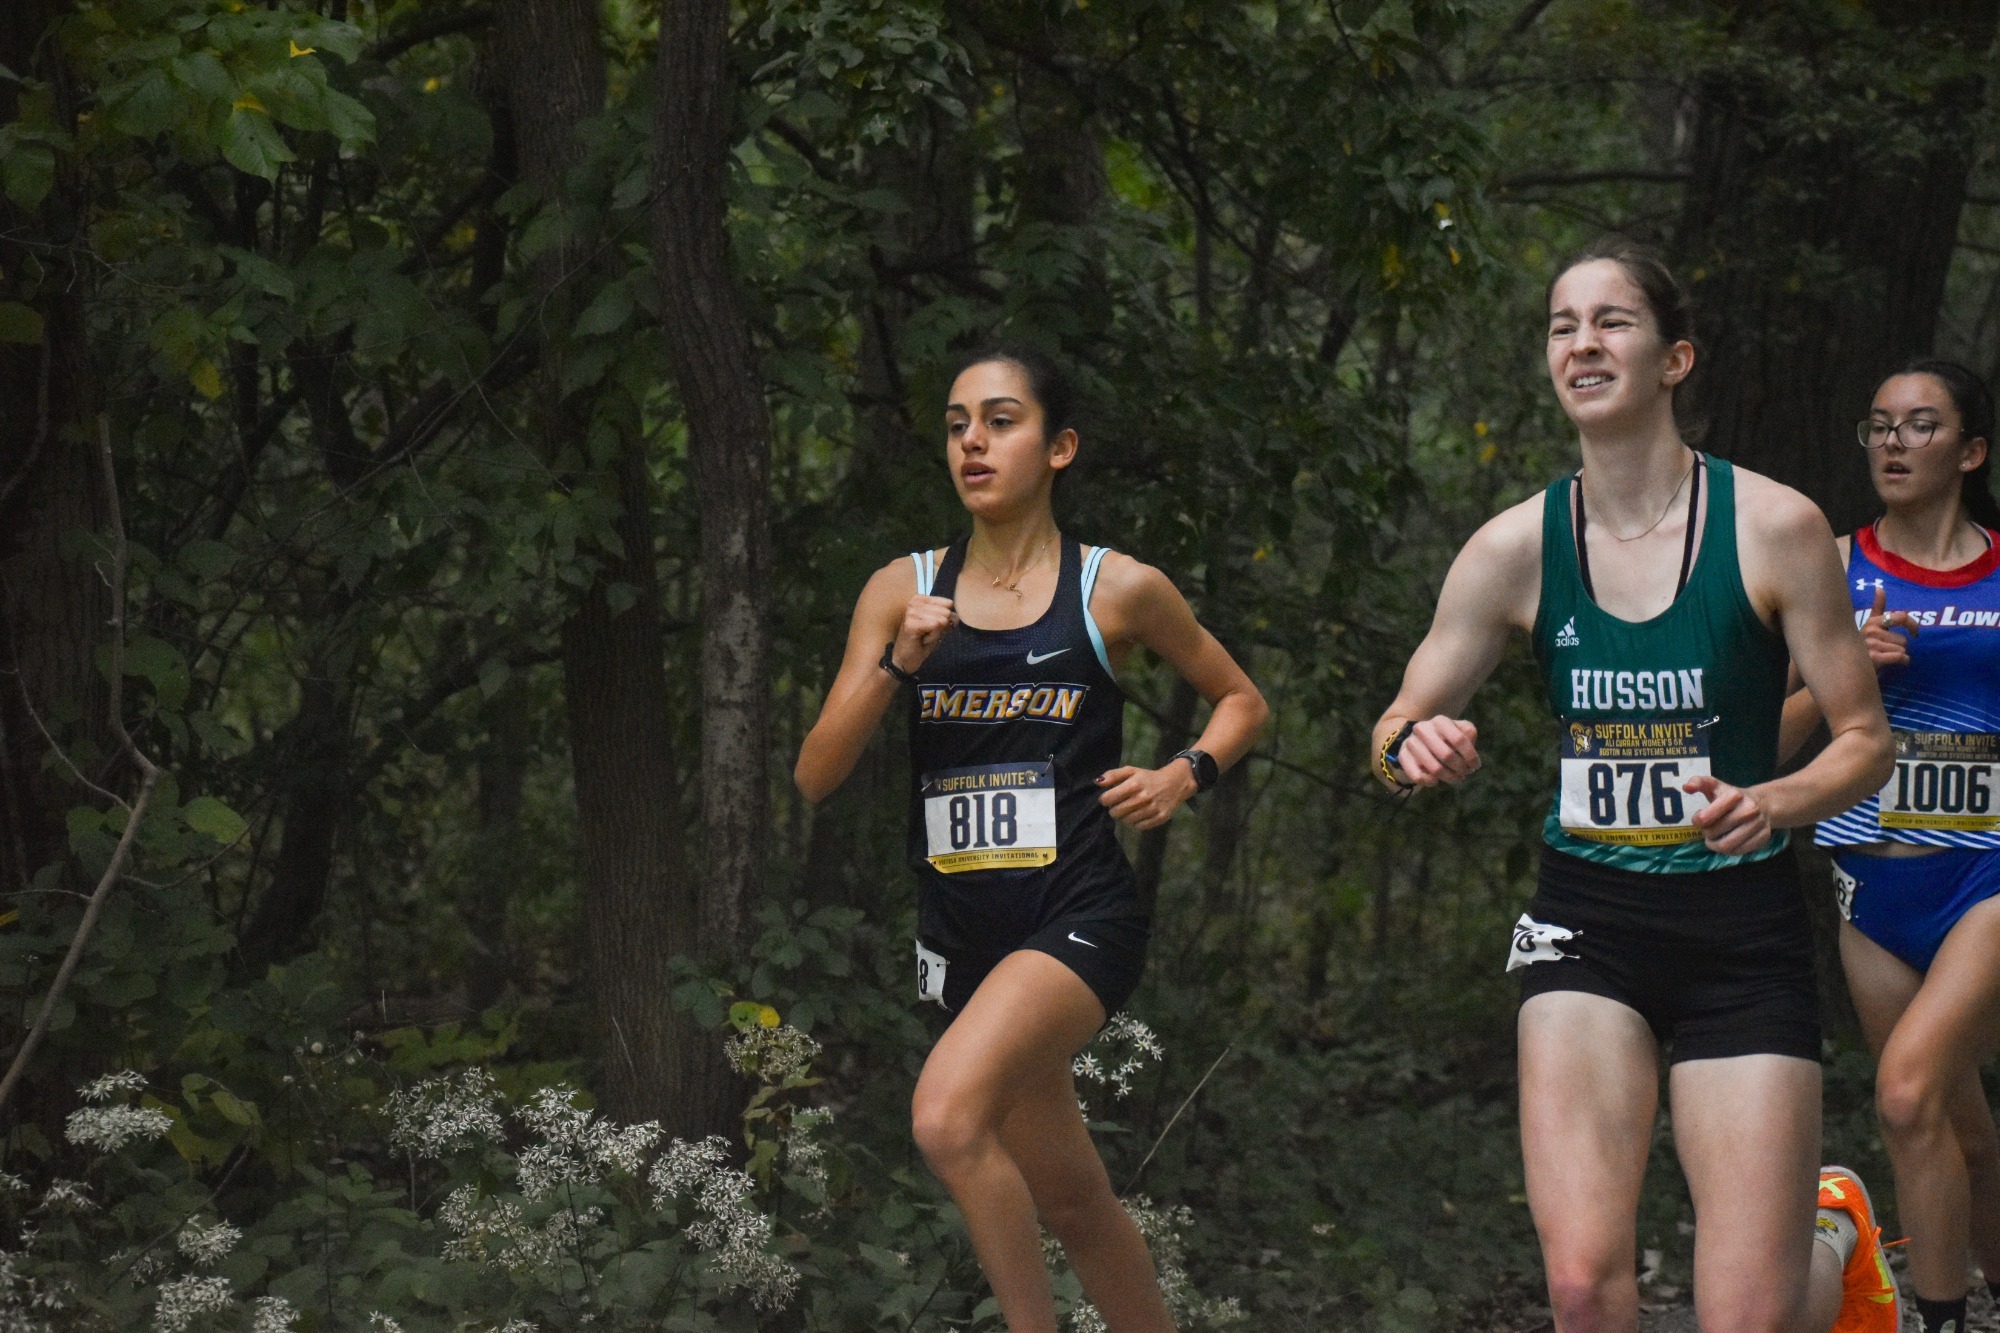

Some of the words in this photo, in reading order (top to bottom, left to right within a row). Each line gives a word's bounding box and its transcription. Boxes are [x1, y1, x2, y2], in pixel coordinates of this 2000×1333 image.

[1555, 635, 1580, 647] adias
[1571, 668, 1704, 710] HUSSON
[920, 687, 1083, 720] EMERSON
[1594, 723, 1647, 739] SUFFOLK
[1651, 722, 1694, 738] INVITE
[1642, 738, 1672, 747] WOMEN'S
[1914, 732, 1961, 746] SUFFOLK
[1965, 734, 1997, 747] INVITE
[1634, 747, 1665, 756] SYSTEMS
[1666, 747, 1687, 755] MEN'S
[942, 776, 986, 792] SUFFOLK
[989, 771, 1025, 787] INVITE
[1894, 763, 1991, 814] 1006
[1588, 762, 1684, 826] 876
[949, 792, 1018, 851] 818
[1652, 830, 1703, 841] INVITATIONA
[958, 853, 990, 863] UNIVERSITY
[991, 851, 1039, 860] INVITATIONAL
